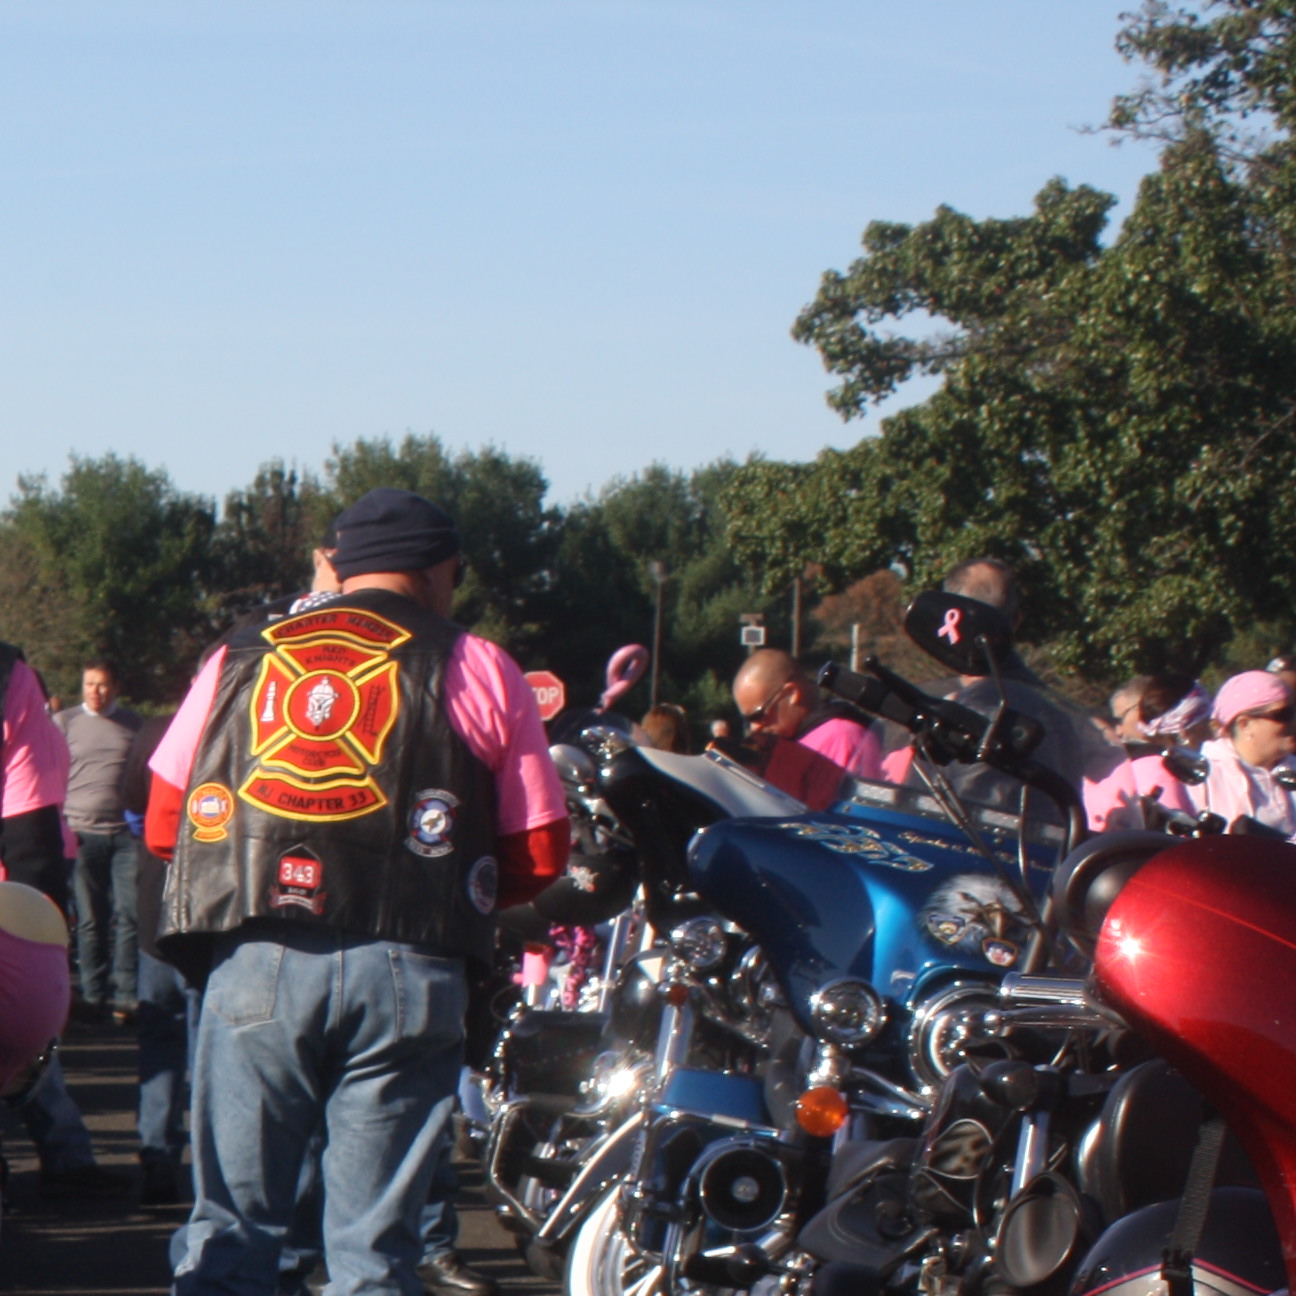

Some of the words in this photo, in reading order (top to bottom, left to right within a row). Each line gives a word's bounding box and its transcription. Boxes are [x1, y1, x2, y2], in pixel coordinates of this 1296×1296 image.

[532, 687, 559, 704] OP
[278, 793, 343, 811] CHAPTER
[349, 792, 367, 807] 33
[281, 863, 314, 884] 343
